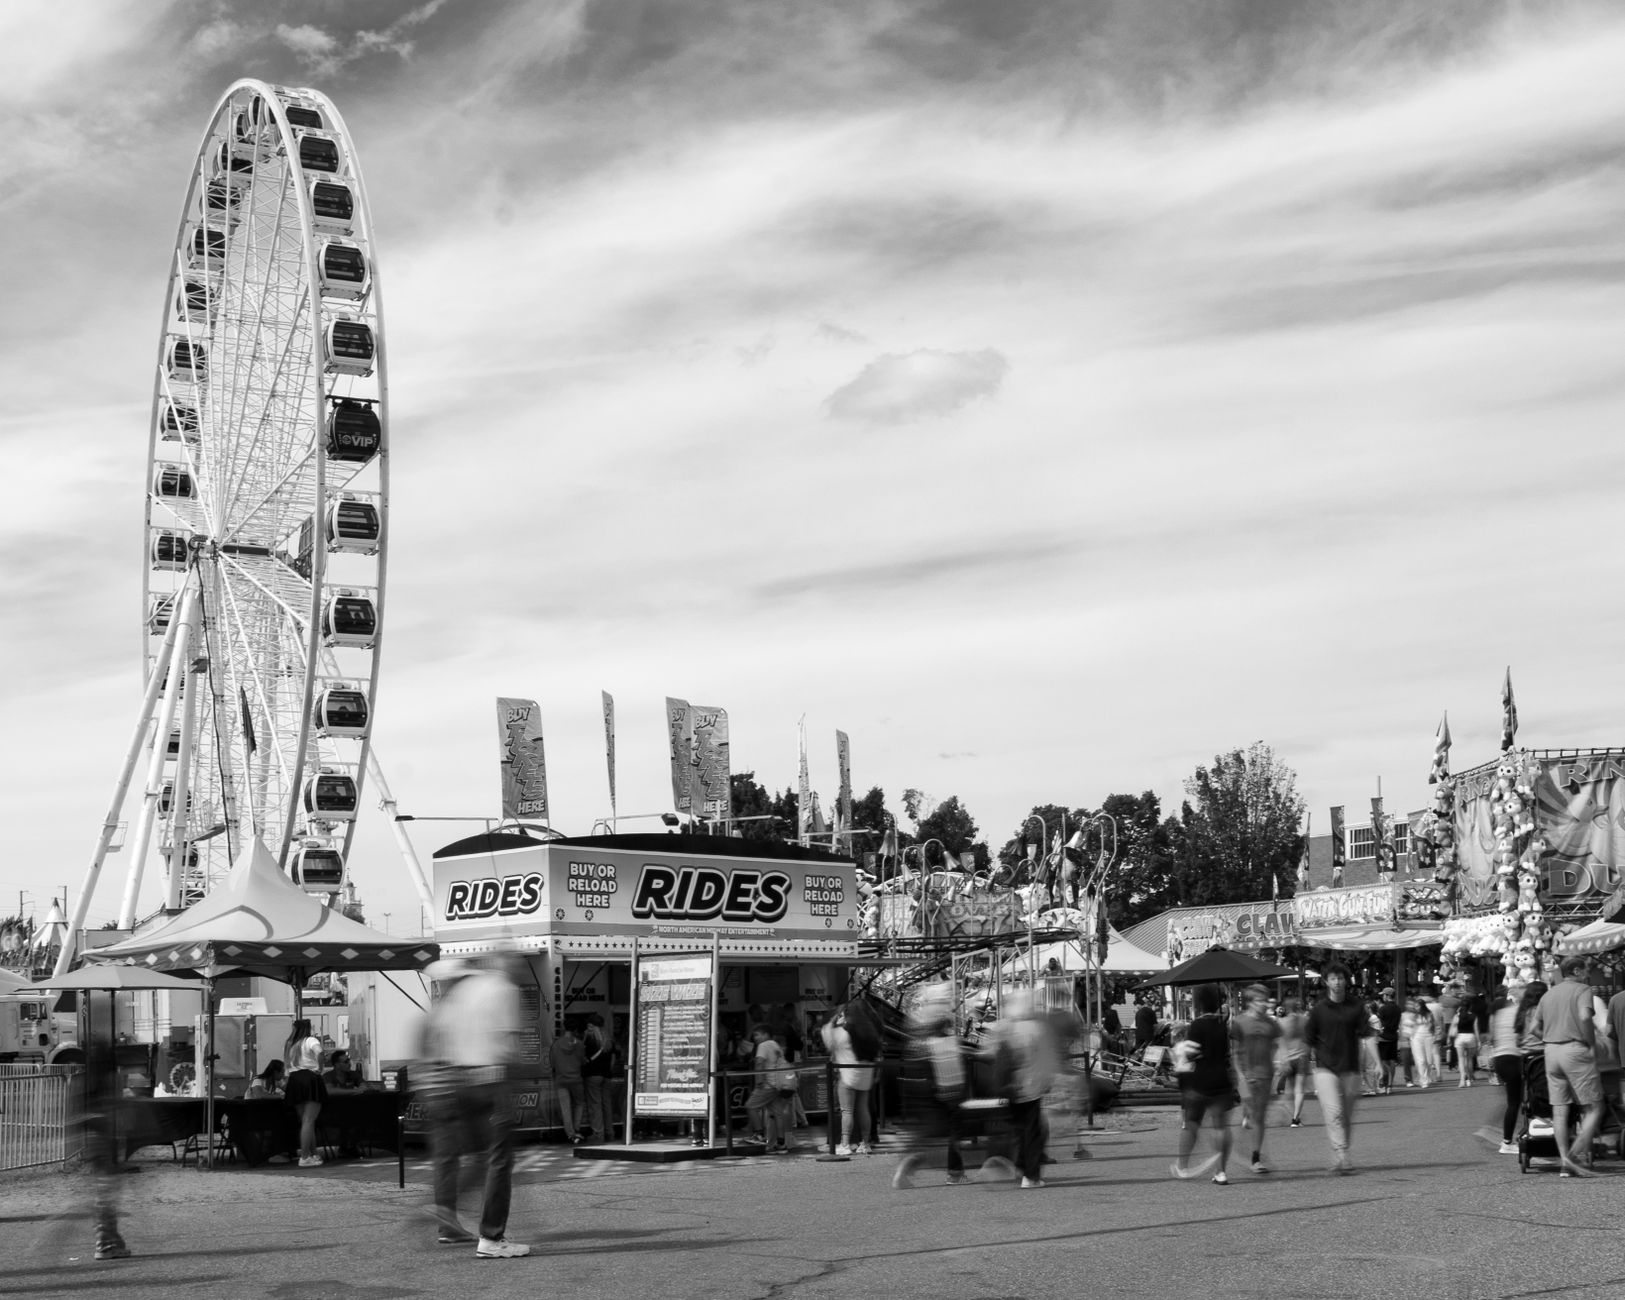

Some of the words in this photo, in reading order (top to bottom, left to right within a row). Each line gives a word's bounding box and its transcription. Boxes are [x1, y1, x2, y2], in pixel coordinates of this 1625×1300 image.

[352, 435, 374, 448] VIP
[507, 707, 531, 723] BUY
[672, 708, 686, 722] BUY
[696, 713, 718, 729] BUY
[518, 799, 545, 815] HERE
[569, 863, 595, 878] BUY
[598, 864, 616, 879] OR
[568, 877, 618, 893] RELOAD
[804, 875, 825, 890] BUY
[826, 876, 843, 891] OR
[446, 873, 544, 921] RIDES
[576, 892, 610, 908] HERE
[632, 864, 793, 922] RIDES
[803, 888, 844, 904] RELOAD
[810, 902, 838, 917] HERE
[1338, 893, 1364, 917] GUN
[658, 926, 677, 934] NORTH
[678, 926, 706, 934] AMERICAN
[706, 927, 727, 935] MIDWAY
[728, 928, 769, 936] ENTERTAINMENT
